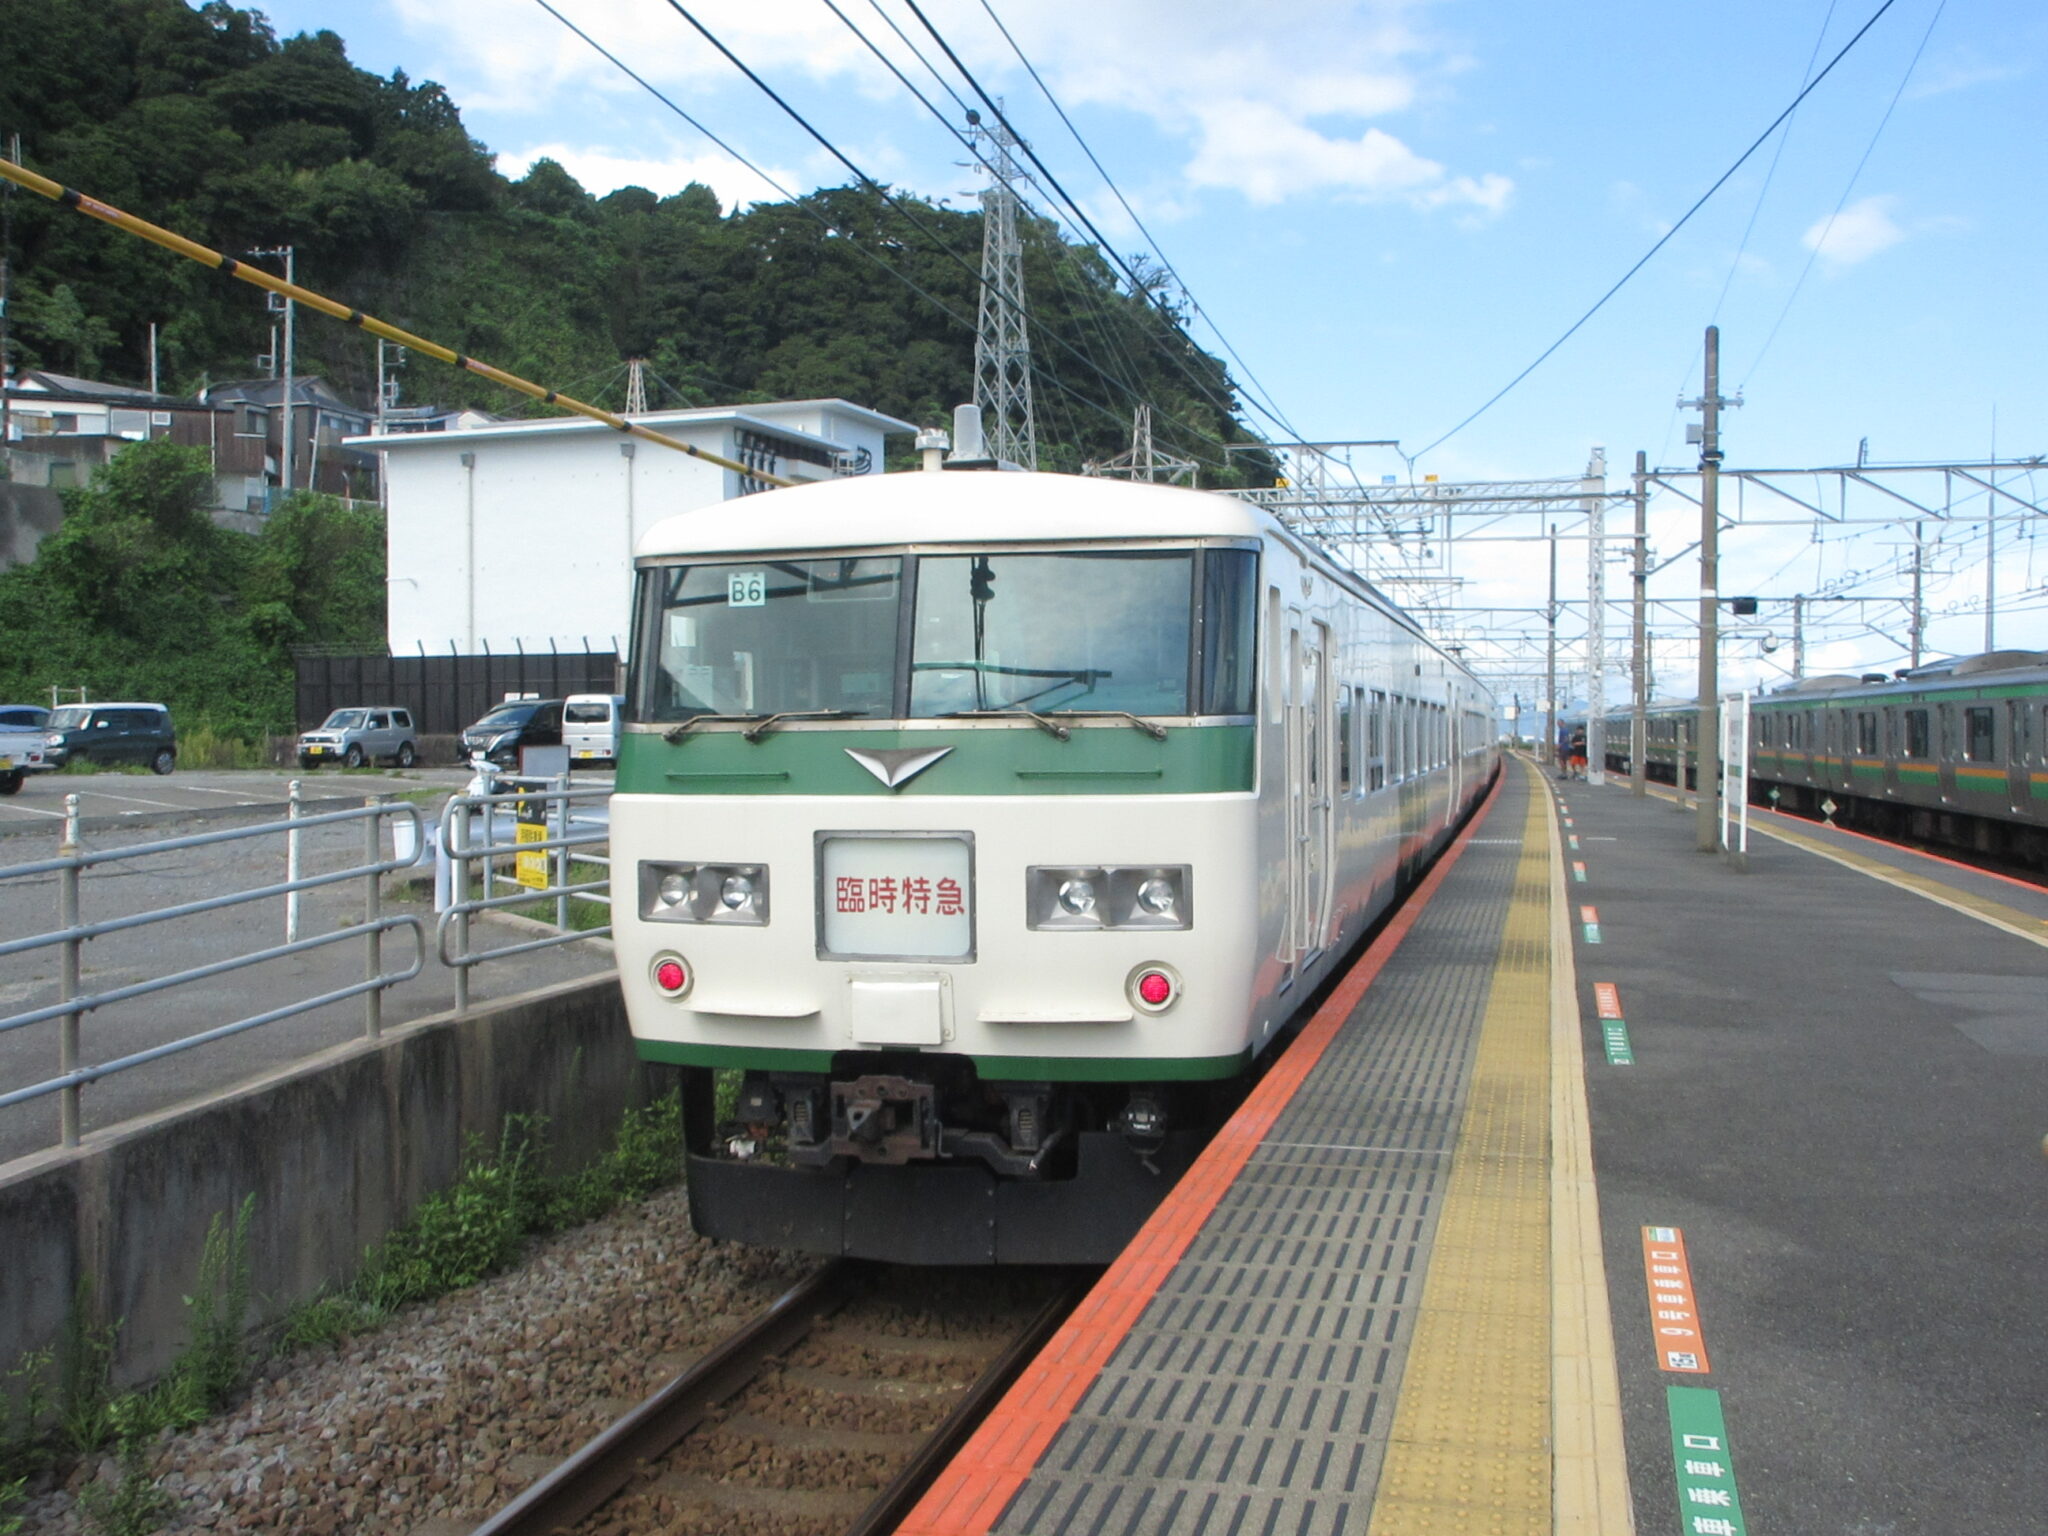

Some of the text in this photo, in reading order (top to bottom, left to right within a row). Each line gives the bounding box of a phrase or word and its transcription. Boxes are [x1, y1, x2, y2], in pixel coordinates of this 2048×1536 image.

[732, 580, 761, 602] B6
[837, 876, 965, 916] 臨時特急
